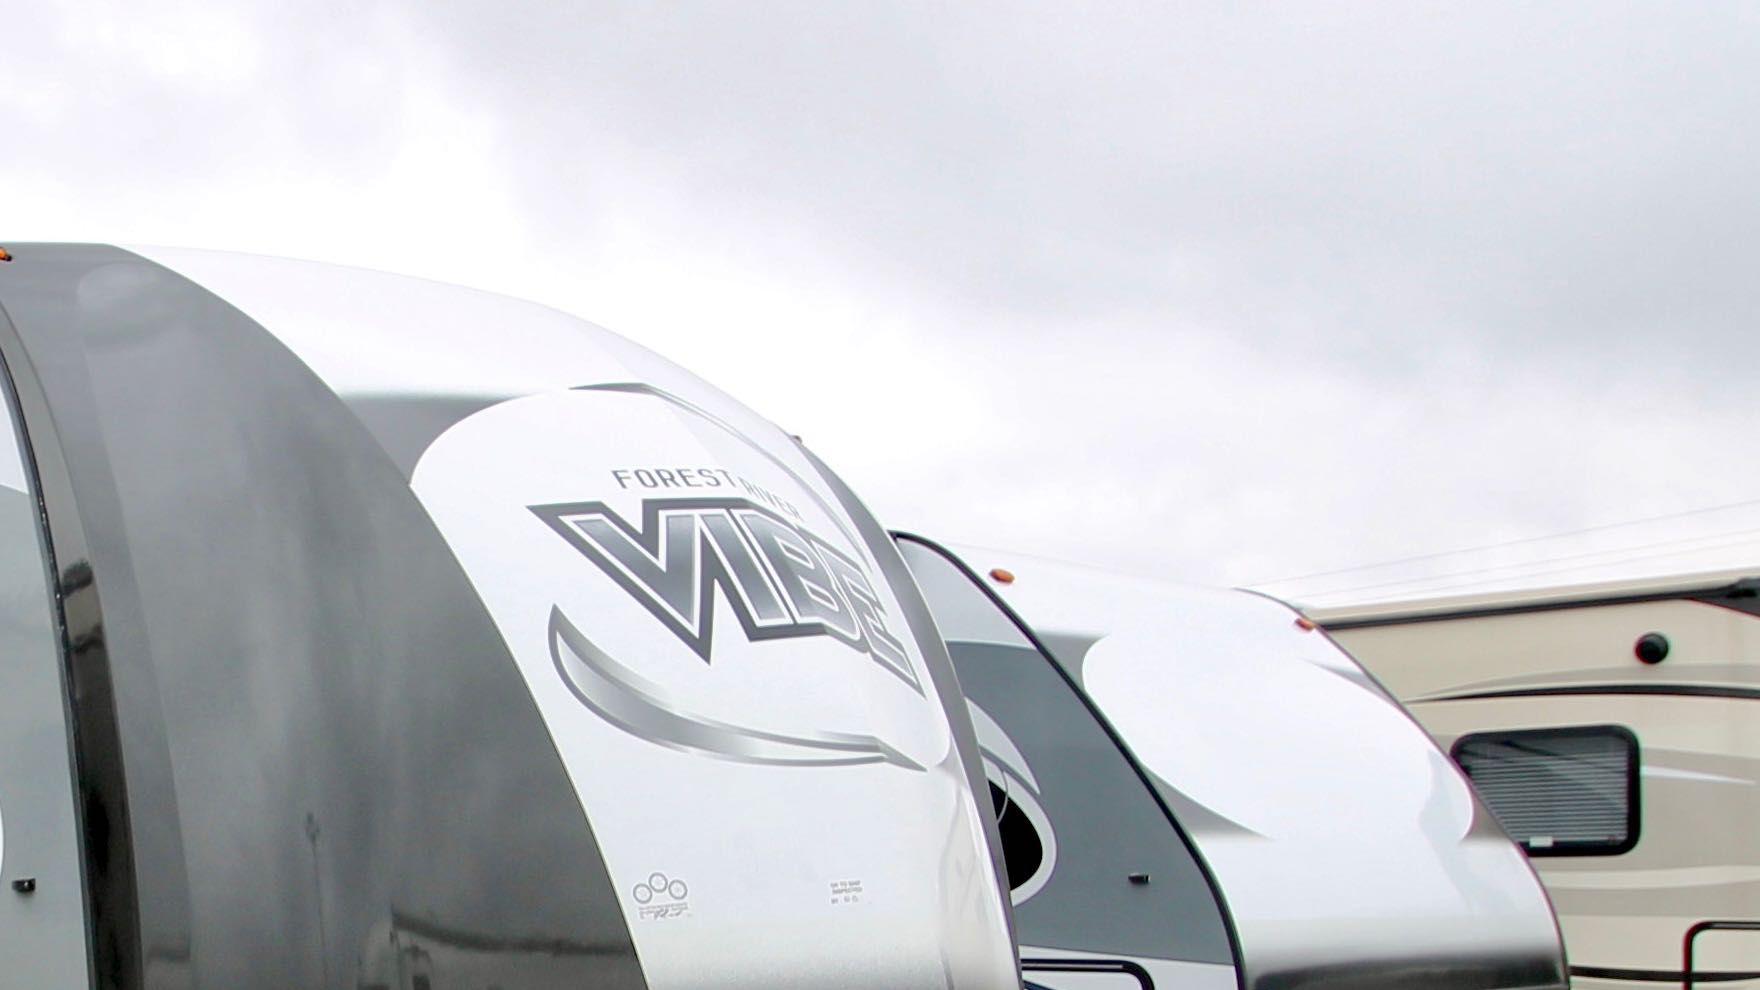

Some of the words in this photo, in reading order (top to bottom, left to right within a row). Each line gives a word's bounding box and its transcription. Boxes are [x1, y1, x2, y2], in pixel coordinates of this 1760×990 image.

[612, 468, 738, 489] FOREST
[738, 476, 804, 521] RIVER
[526, 496, 928, 700] VIBE
